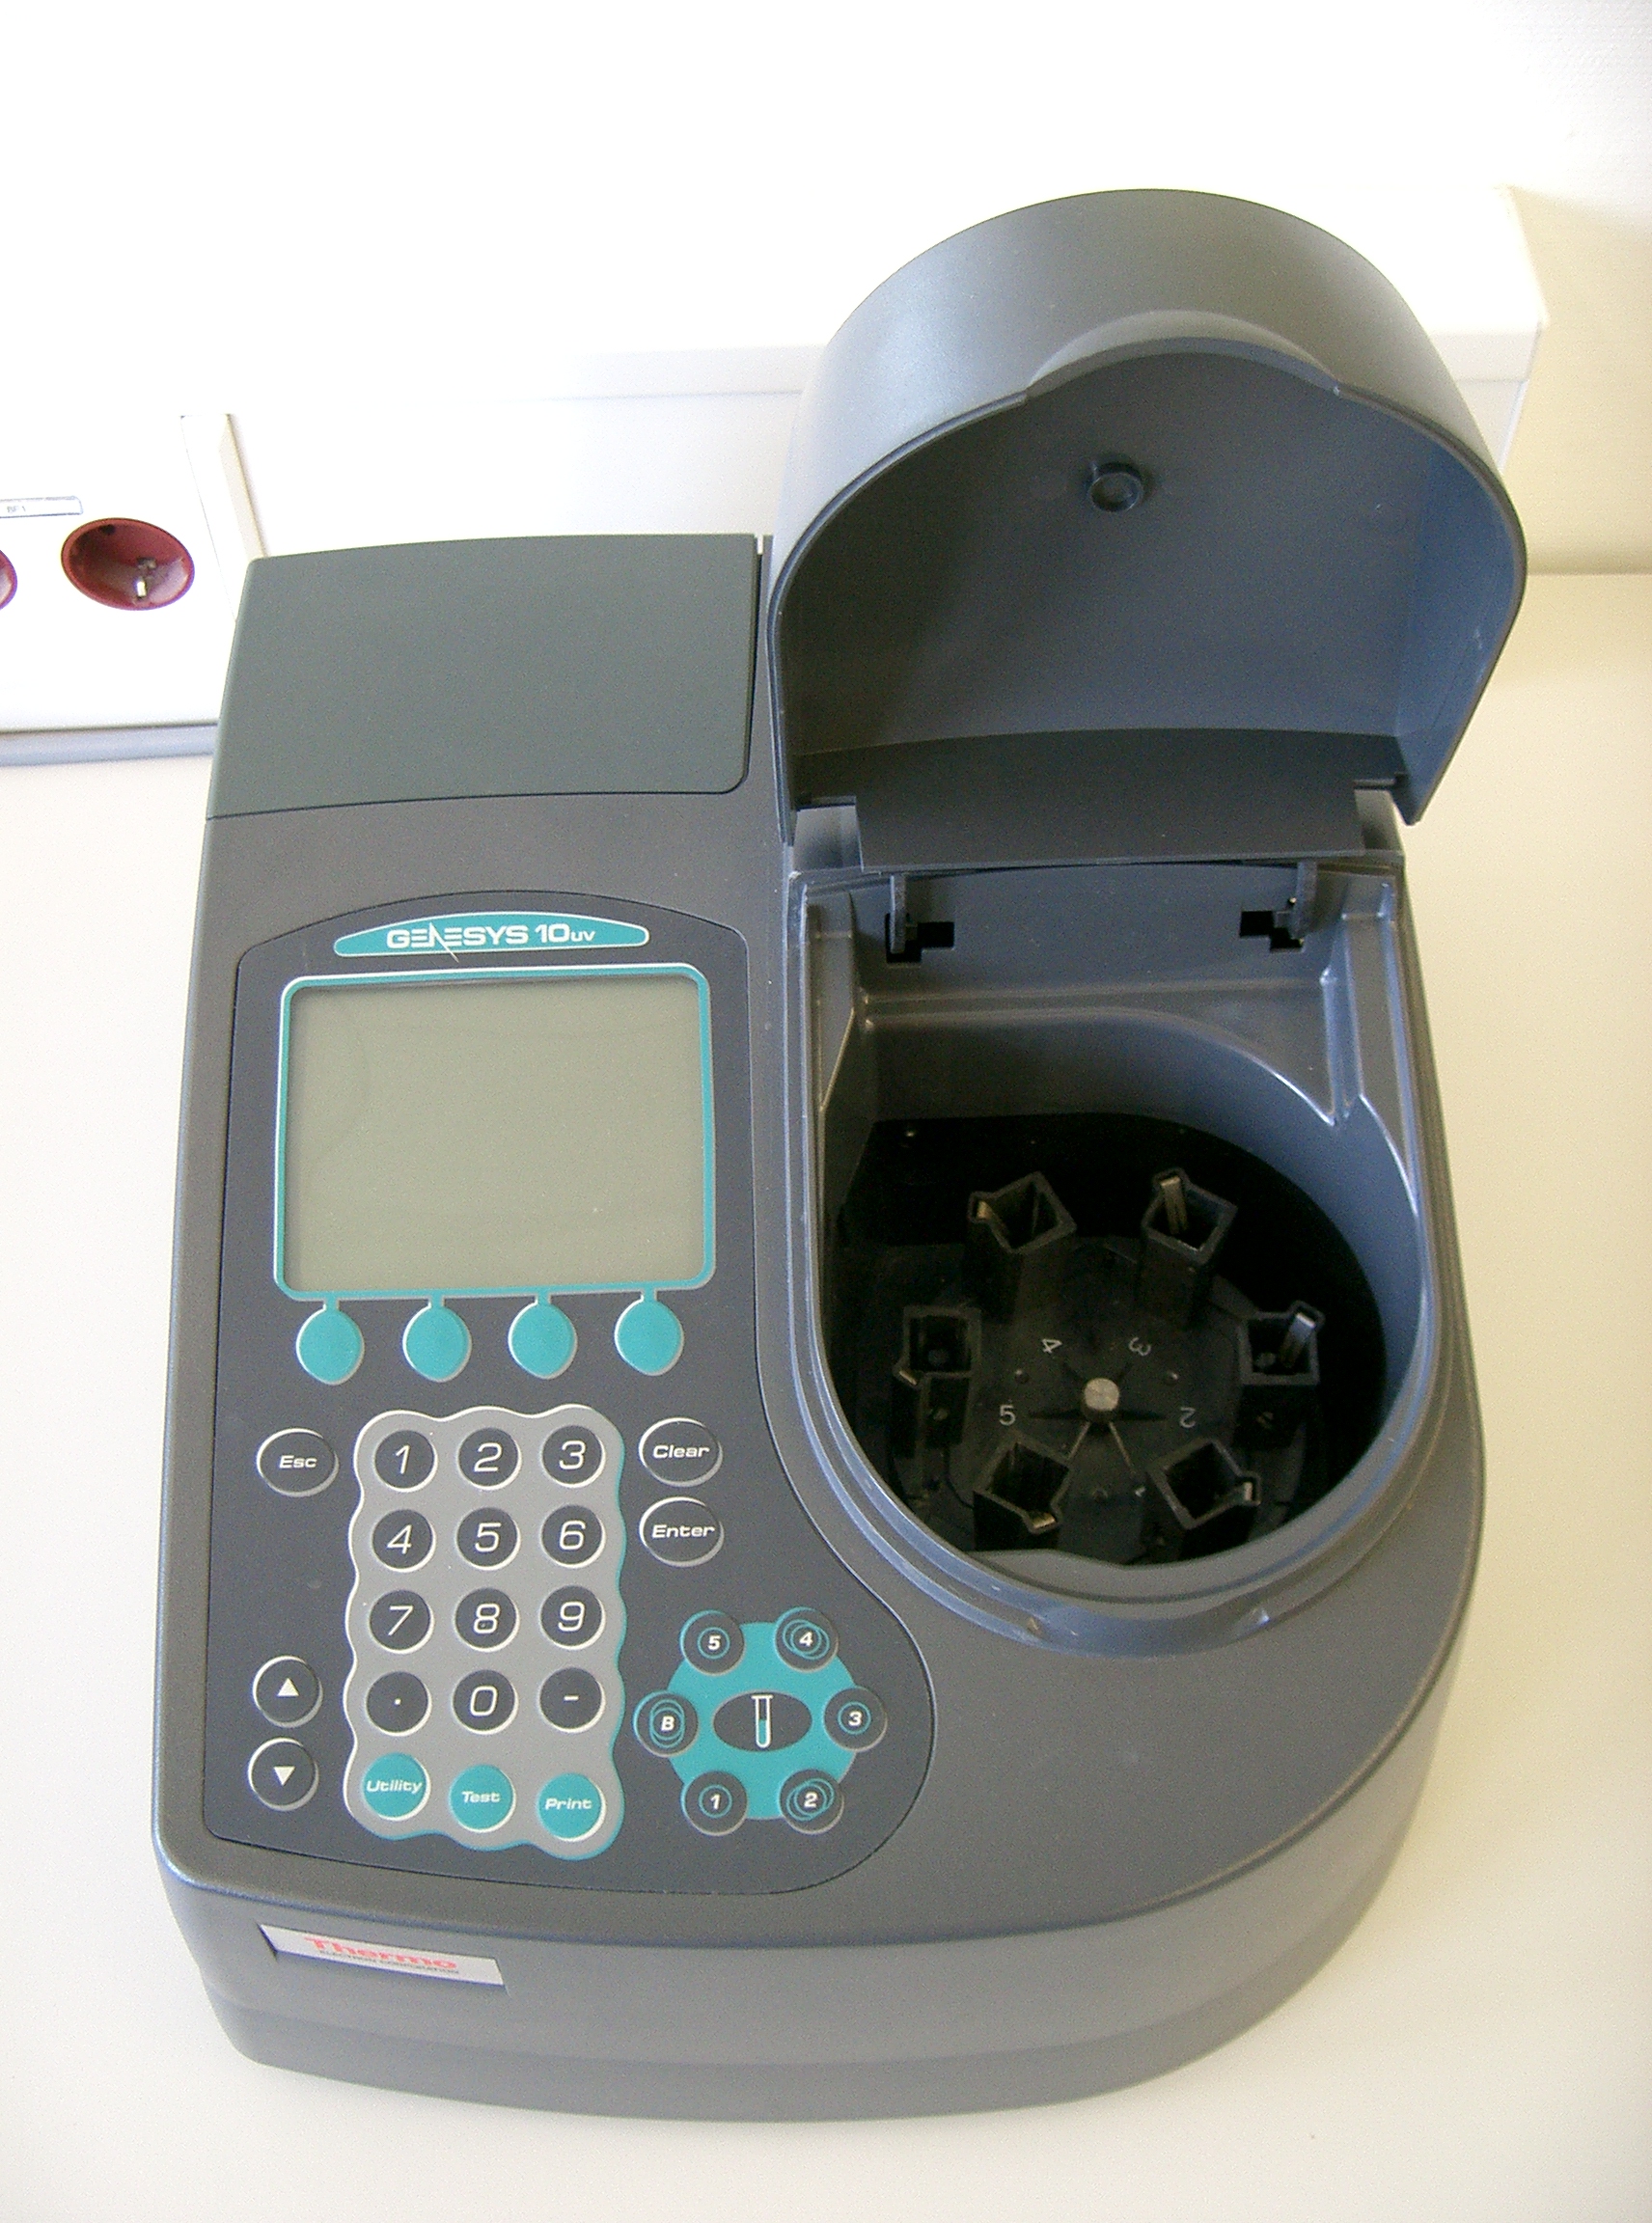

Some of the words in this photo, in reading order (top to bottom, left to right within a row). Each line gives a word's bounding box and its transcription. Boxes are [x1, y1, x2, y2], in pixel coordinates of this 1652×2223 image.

[387, 923, 529, 962] GENESYS
[1041, 1337, 1063, 1355] 4
[1127, 1335, 1152, 1358] 3
[998, 1404, 1017, 1427] 5
[1178, 1406, 1197, 1430] 2
[278, 1455, 317, 1469] Esc
[394, 1445, 410, 1475] 1
[473, 1442, 503, 1473] 2
[558, 1441, 587, 1471] 3
[652, 1444, 711, 1460] Clear
[386, 1523, 413, 1555] 4
[474, 1523, 502, 1553] 5
[558, 1520, 587, 1551] 6
[651, 1524, 716, 1540] Enter
[387, 1605, 414, 1636] 7
[472, 1602, 501, 1634] 8
[557, 1601, 586, 1633] 9
[706, 1634, 722, 1651] 5
[798, 1631, 813, 1648] 4
[469, 1685, 498, 1717] 0
[660, 1715, 675, 1732] B
[847, 1710, 863, 1727] 3
[366, 1777, 424, 1796] Utility
[461, 1790, 502, 1805] Test
[544, 1797, 592, 1812] Print
[709, 1794, 722, 1810] 1
[803, 1791, 818, 1809] 2
[304, 1936, 458, 1969] Thermo
